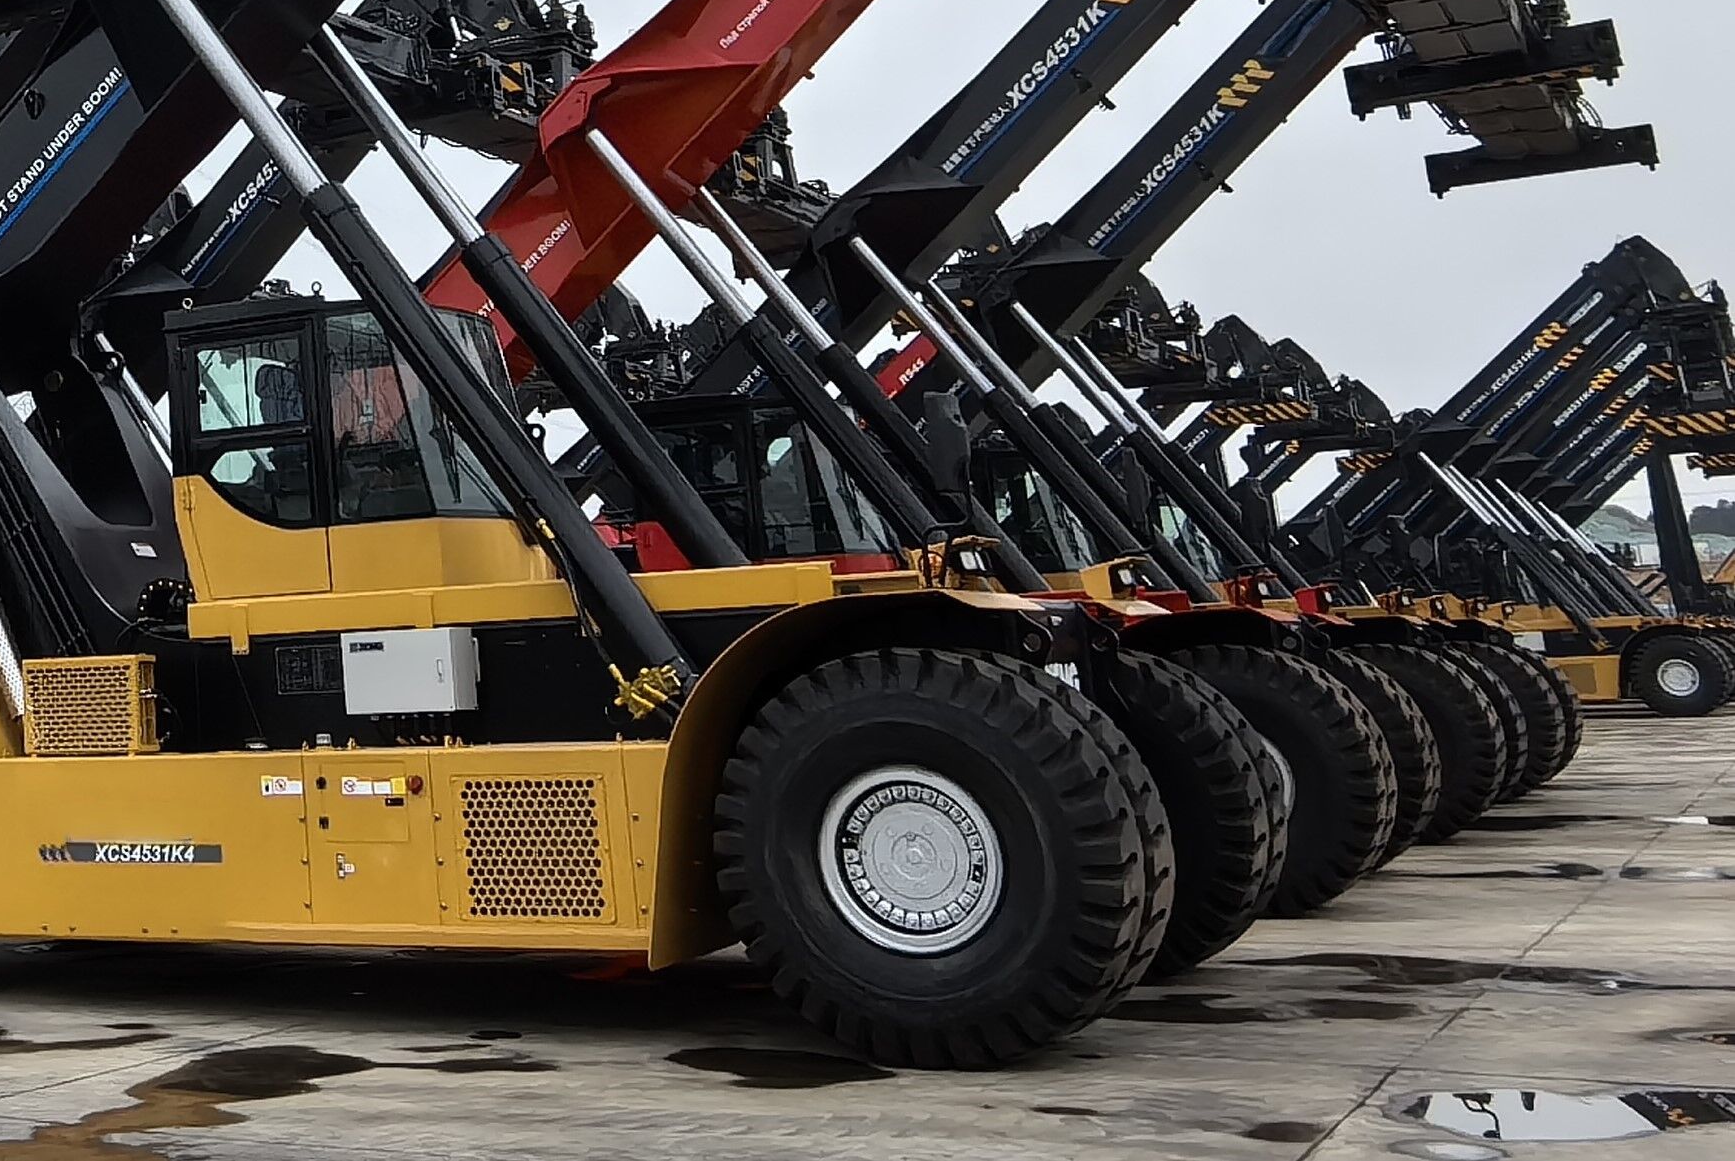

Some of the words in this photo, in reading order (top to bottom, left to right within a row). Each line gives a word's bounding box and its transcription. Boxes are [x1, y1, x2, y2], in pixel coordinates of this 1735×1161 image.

[1006, 0, 1107, 110] XCS4531K
[6, 157, 45, 204] STAND
[42, 112, 84, 160] UNDER
[81, 66, 124, 116] BOOM!
[538, 218, 573, 256] BOOM!
[95, 844, 194, 862] XCS4531K4
